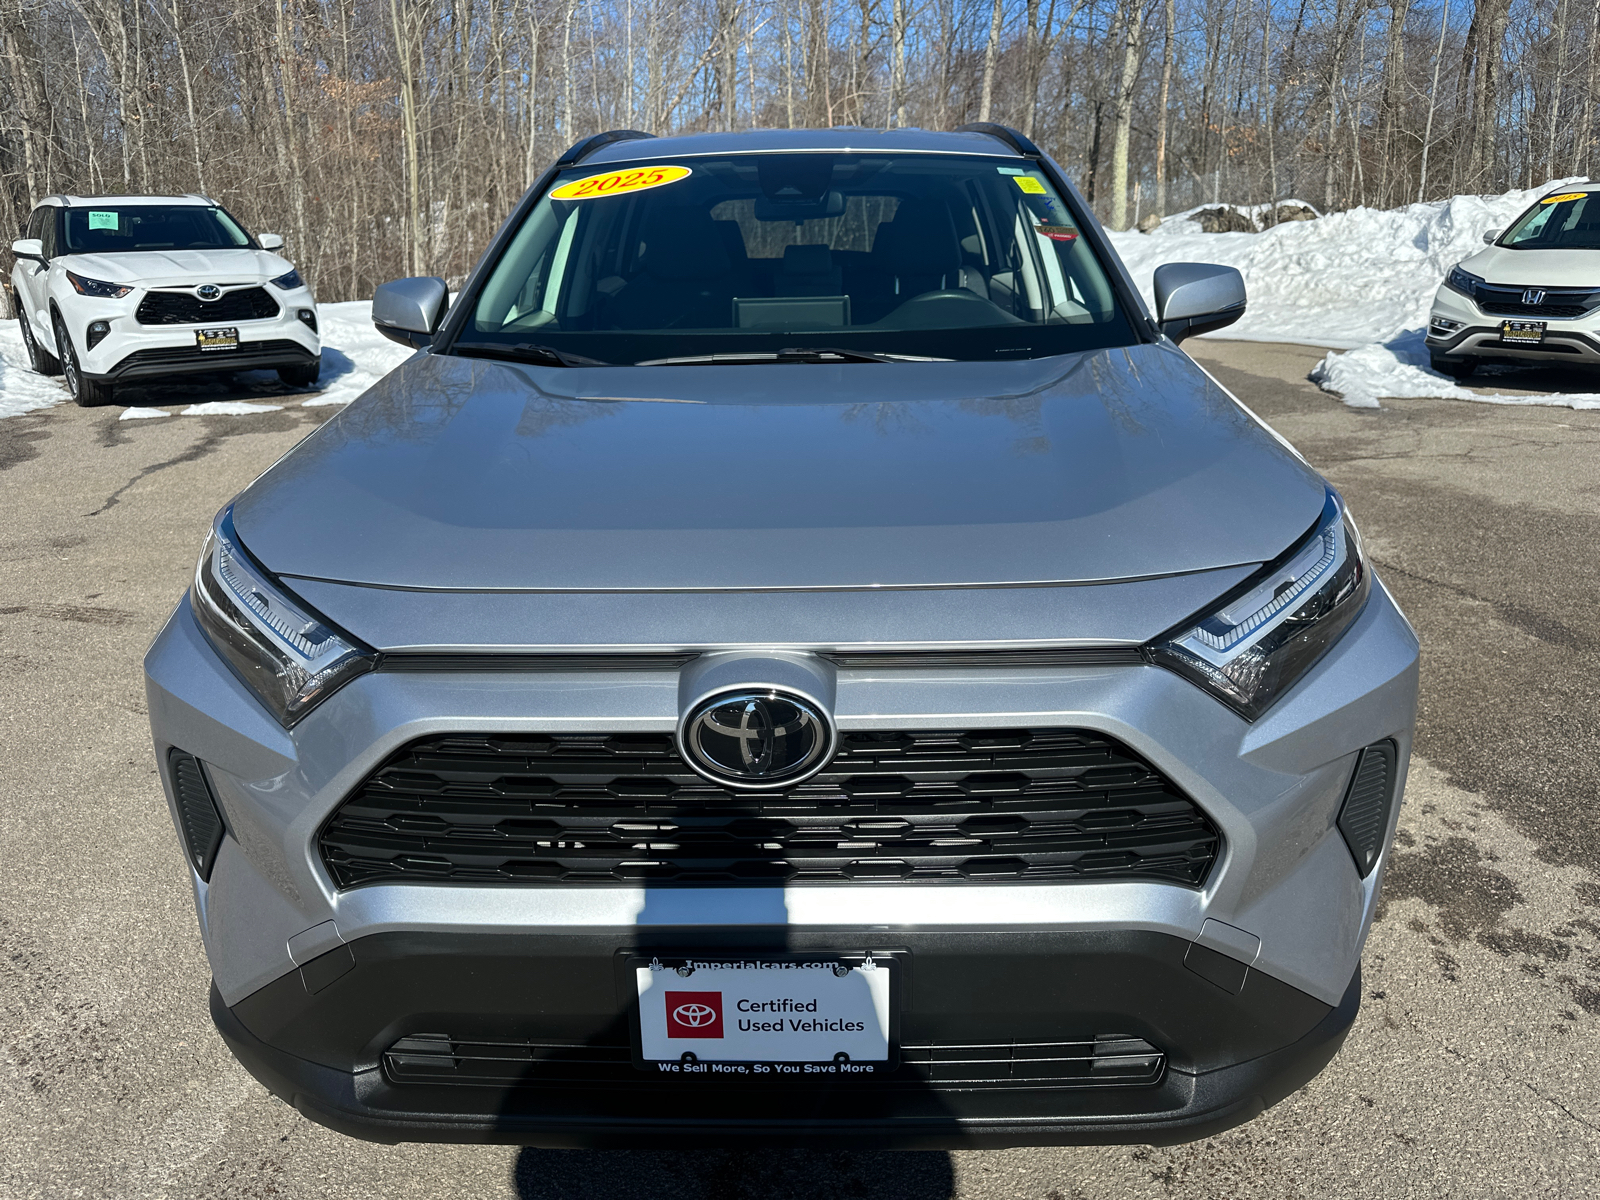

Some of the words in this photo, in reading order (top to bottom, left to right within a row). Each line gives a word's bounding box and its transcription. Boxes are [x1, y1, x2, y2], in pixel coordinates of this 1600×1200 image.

[572, 169, 668, 196] 2025
[685, 960, 839, 971] Imperialcars.com
[736, 998, 818, 1013] Certified
[738, 1018, 784, 1032] Used
[788, 1018, 865, 1032] Vehicles
[658, 1063, 680, 1072] We
[683, 1063, 708, 1073] Sell
[712, 1064, 749, 1075] More,
[753, 1064, 770, 1073] So
[774, 1064, 800, 1073] You
[803, 1064, 836, 1073] Save
[840, 1064, 874, 1073] More
